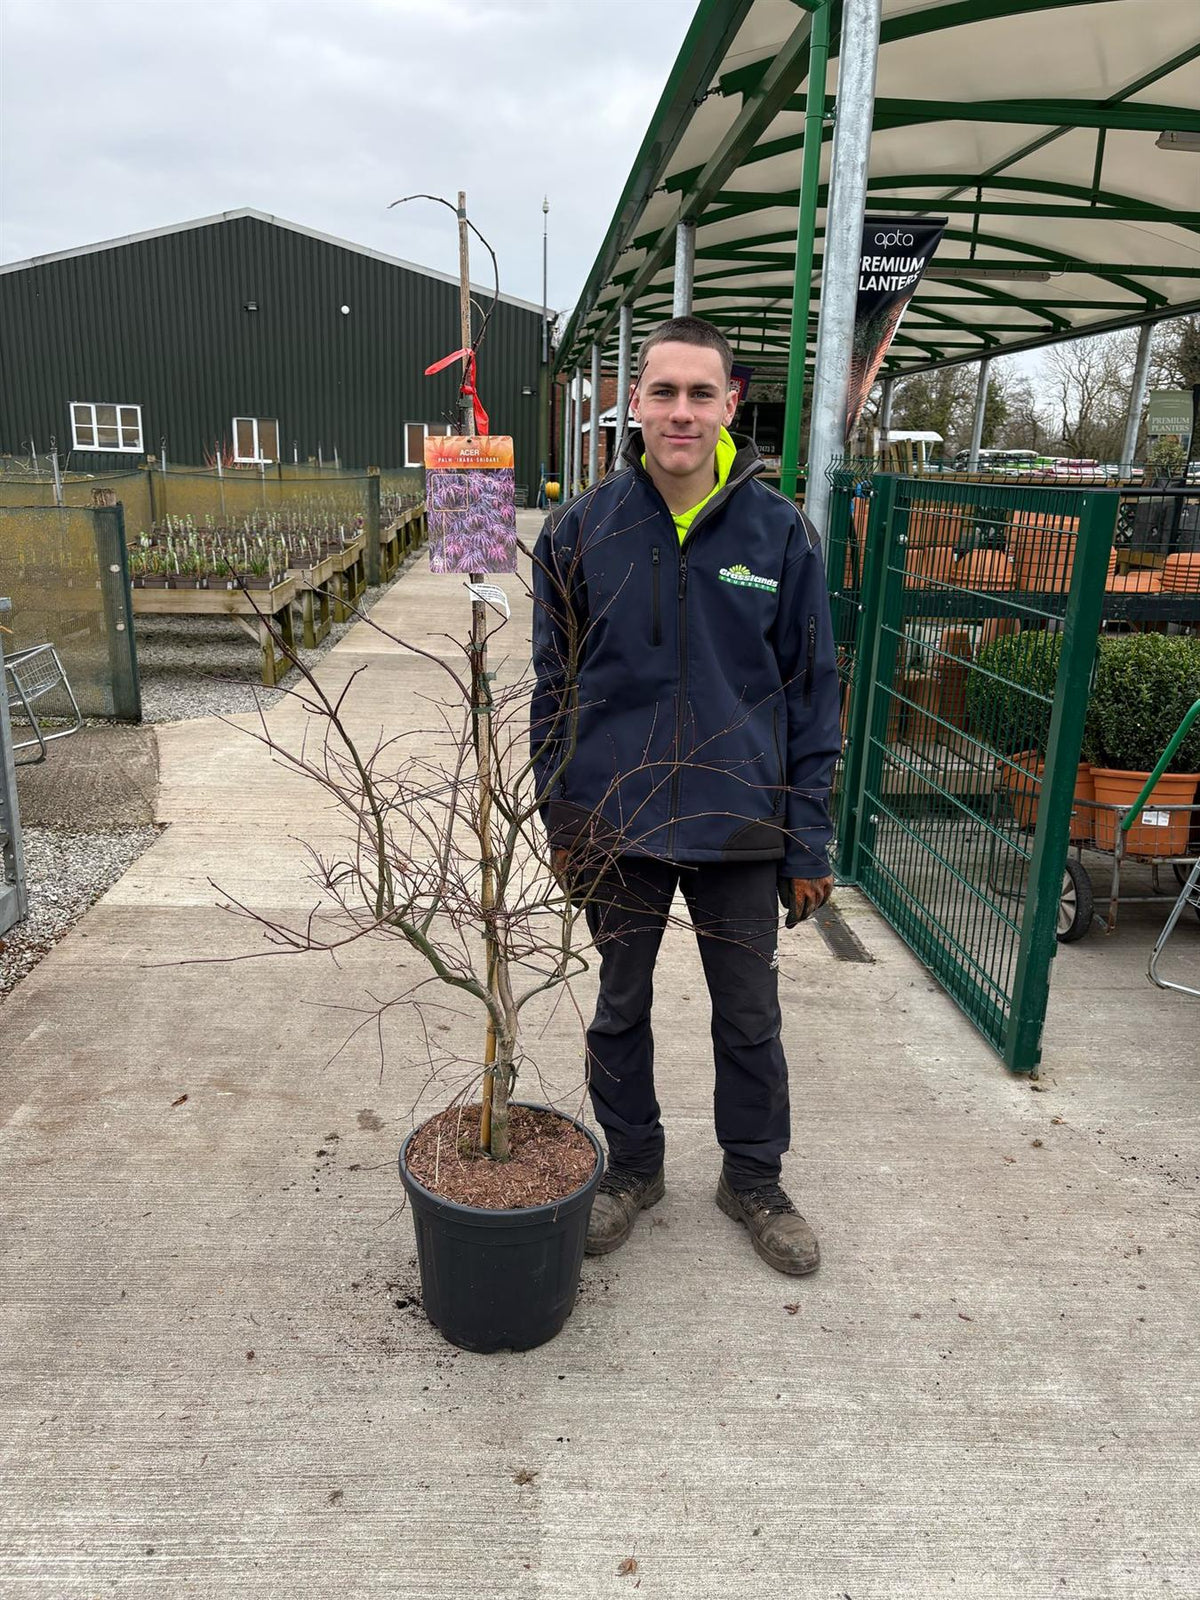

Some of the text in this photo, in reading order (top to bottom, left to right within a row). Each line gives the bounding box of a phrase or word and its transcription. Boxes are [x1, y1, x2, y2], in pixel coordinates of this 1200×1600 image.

[874, 229, 914, 249] apta
[859, 255, 926, 273] REMIUM
[858, 270, 920, 291] LANTERS
[1151, 424, 1190, 432] PLANTERS
[1152, 416, 1190, 424] PREMIUM
[719, 568, 779, 588] Grasslands
